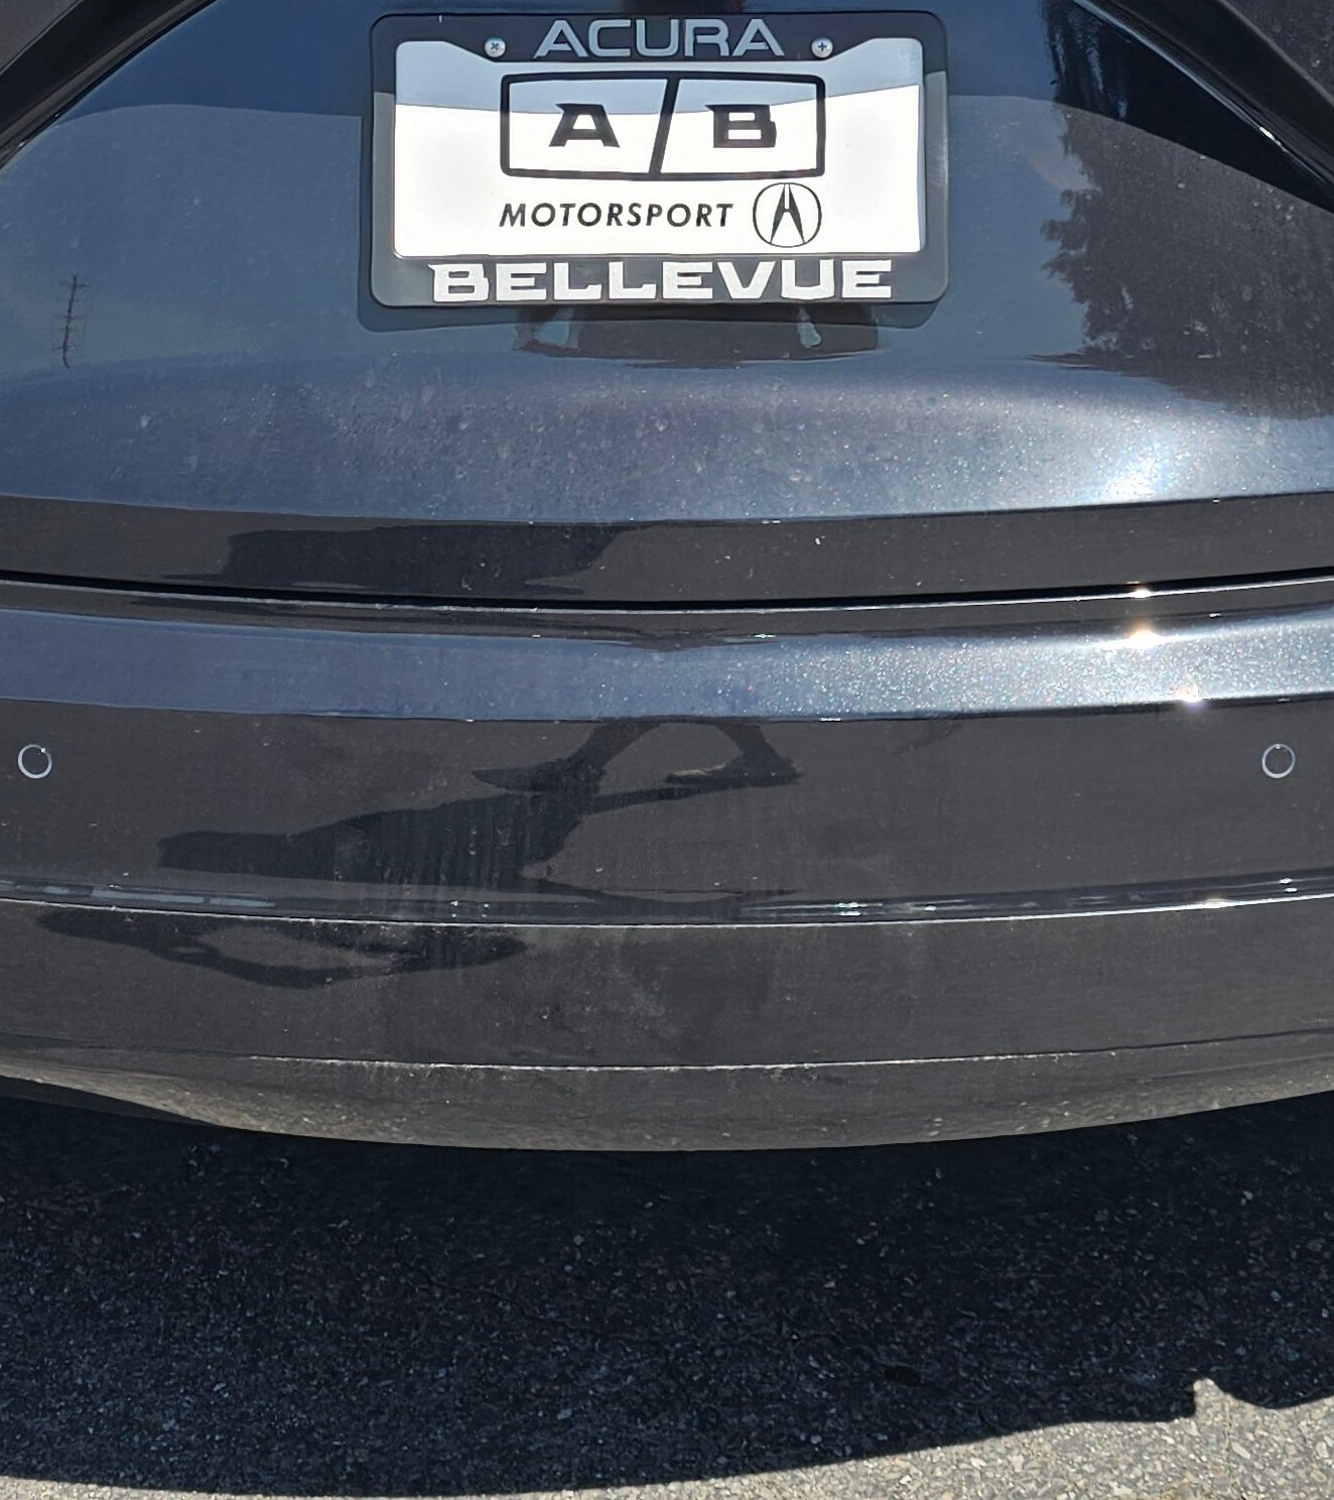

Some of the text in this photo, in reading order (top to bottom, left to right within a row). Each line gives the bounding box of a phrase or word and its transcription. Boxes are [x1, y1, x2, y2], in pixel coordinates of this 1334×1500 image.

[533, 18, 785, 59] ACURA
[498, 202, 734, 228] MOTORSPORT
[427, 258, 893, 303] BELLEVUE
